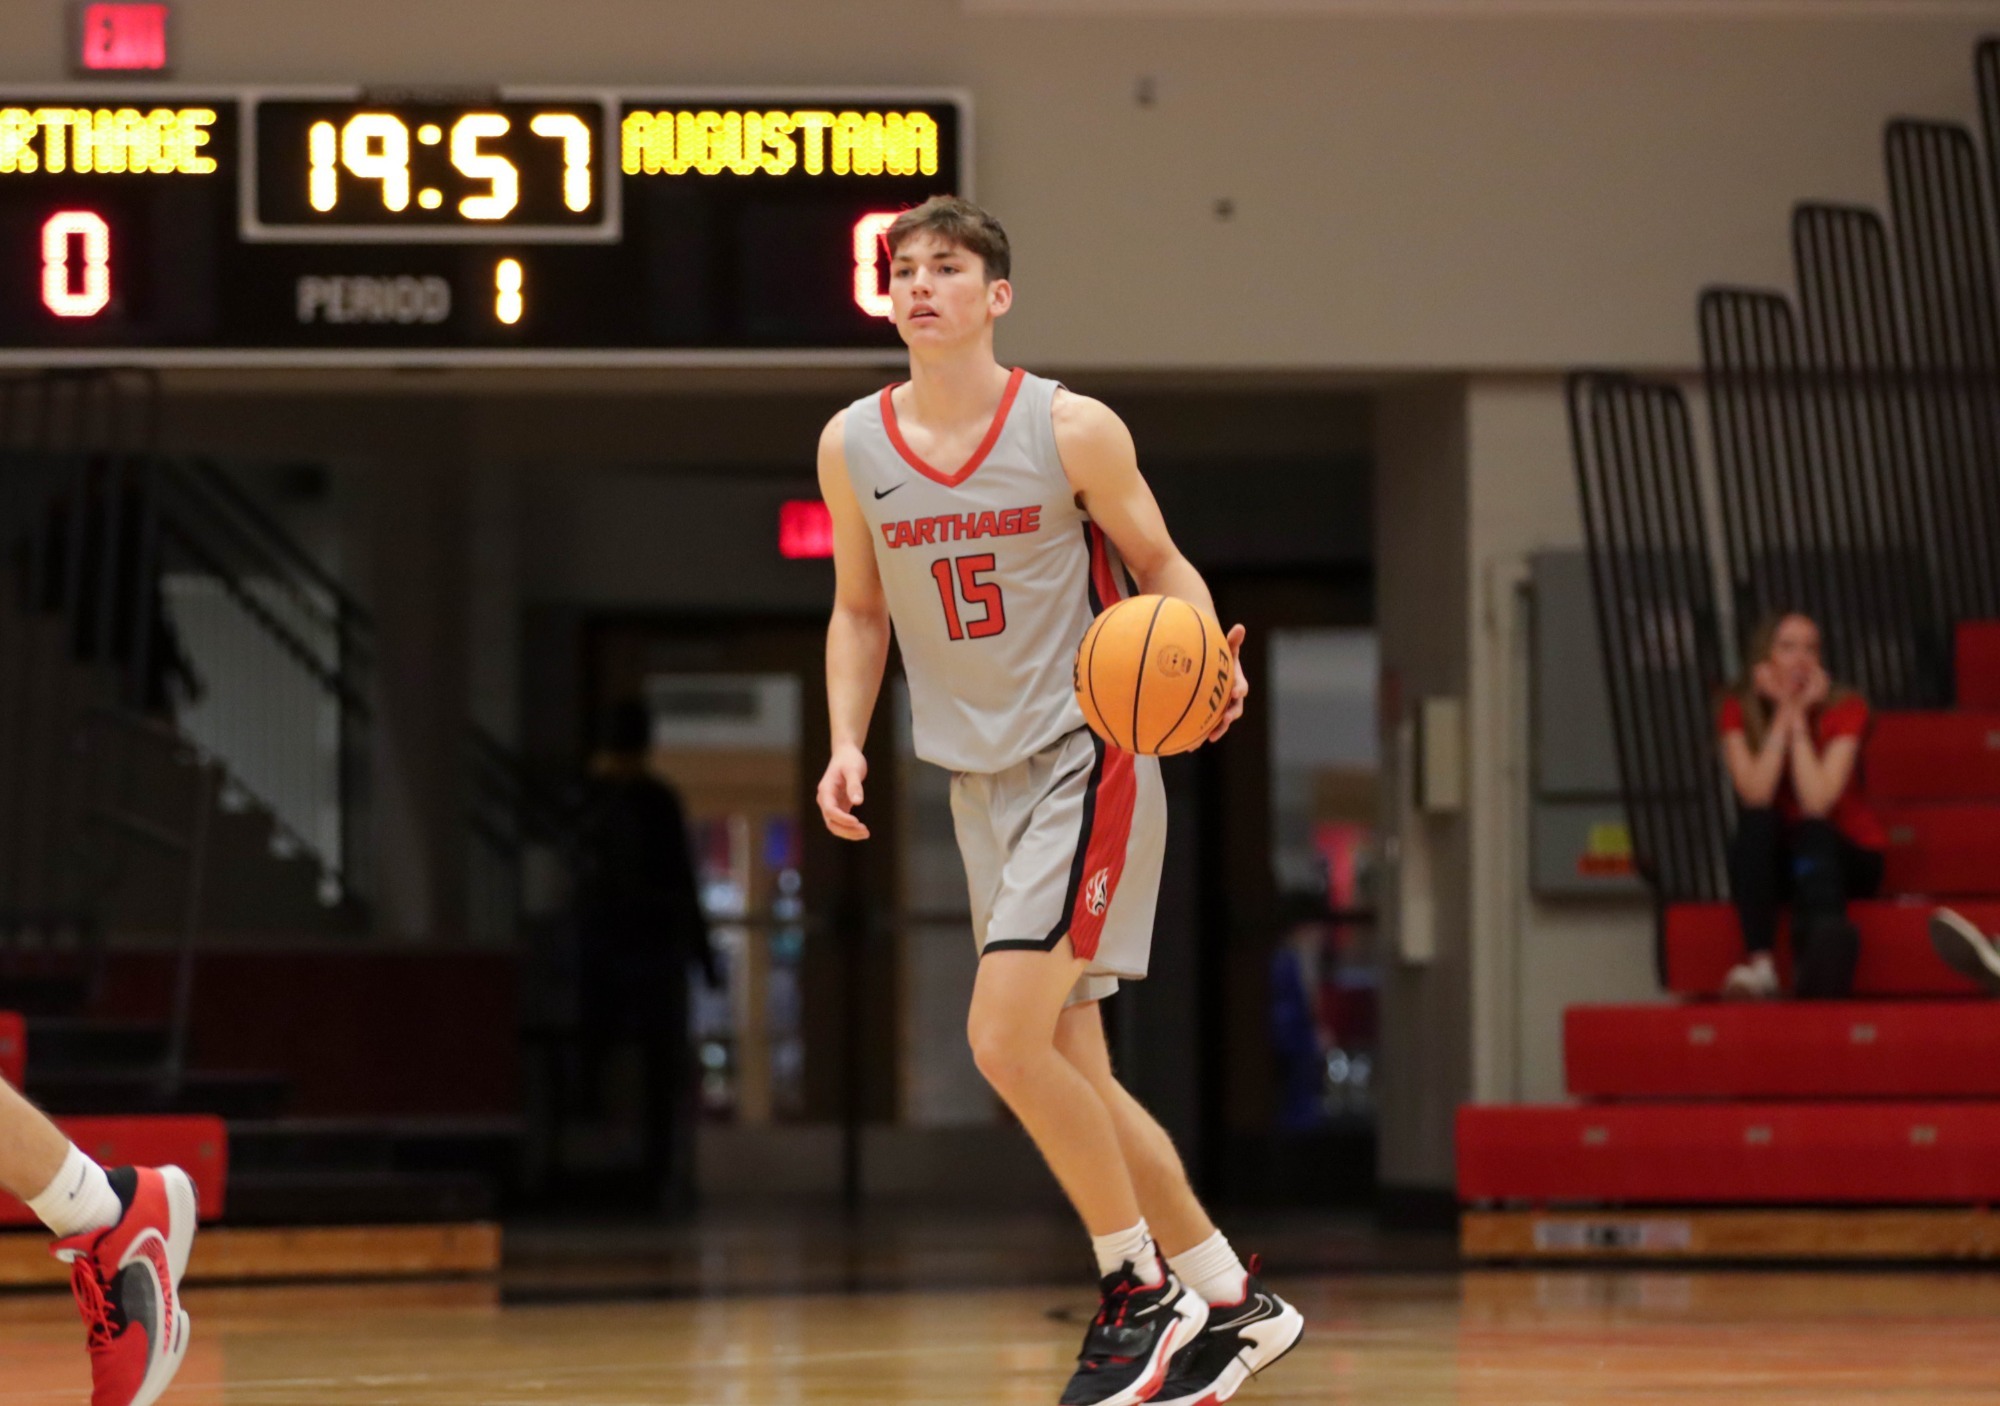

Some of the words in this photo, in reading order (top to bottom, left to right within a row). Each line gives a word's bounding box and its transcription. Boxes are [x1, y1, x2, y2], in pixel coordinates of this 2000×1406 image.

[309, 113, 591, 219] 19:57
[621, 110, 938, 175] AUGUSTANA
[42, 210, 110, 317] 0
[297, 275, 450, 324] PERIOD
[496, 259, 522, 324] 1
[881, 504, 1042, 549] CARTHAGE
[930, 552, 1007, 641] 15
